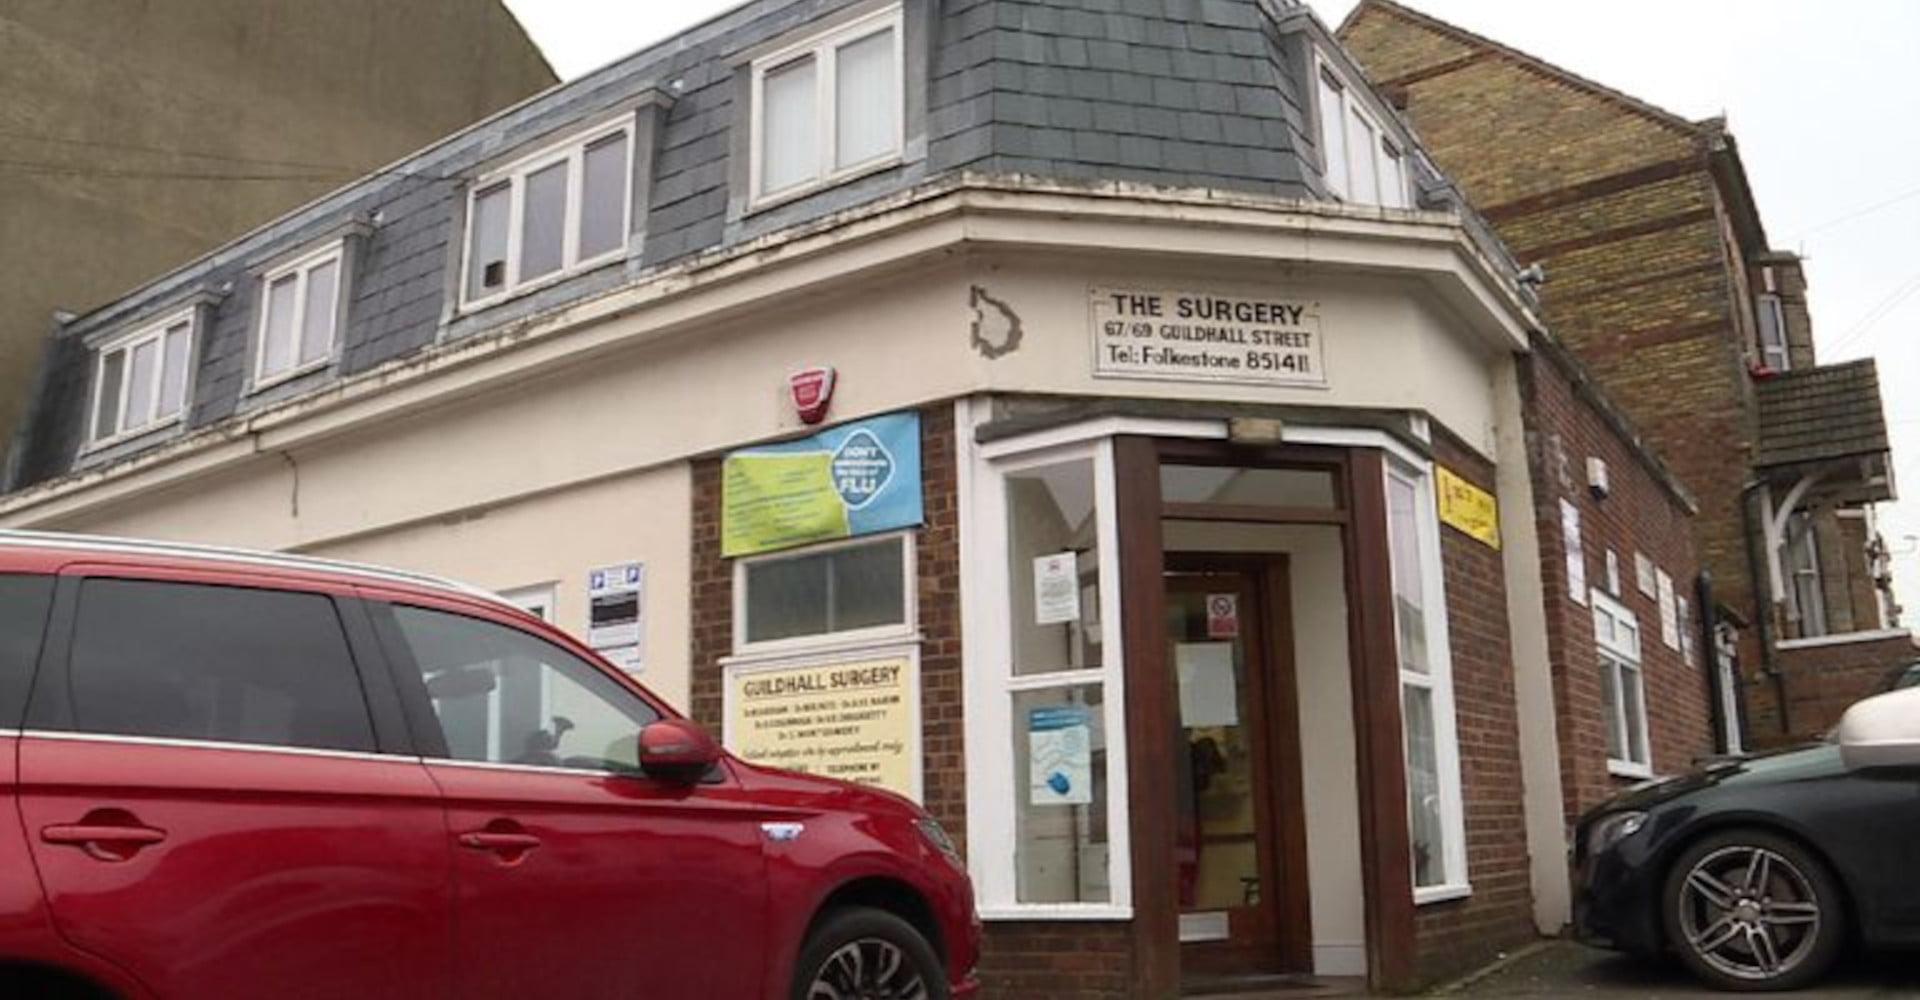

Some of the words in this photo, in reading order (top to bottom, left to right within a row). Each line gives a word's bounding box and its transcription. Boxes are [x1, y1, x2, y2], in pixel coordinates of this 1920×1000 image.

[1110, 293, 1163, 317] THE
[1177, 297, 1304, 326] SURGERY
[1104, 321, 1153, 338] 67/69
[1159, 324, 1247, 344] GUILDHALL
[1251, 329, 1312, 348] STREET
[1106, 343, 1140, 364] Tel:
[1142, 345, 1241, 368] Folkestone
[1246, 351, 1310, 373] 851411
[840, 477, 877, 494] FLU
[743, 675, 826, 697] GUILDHALL
[830, 666, 900, 688] SURGERY
